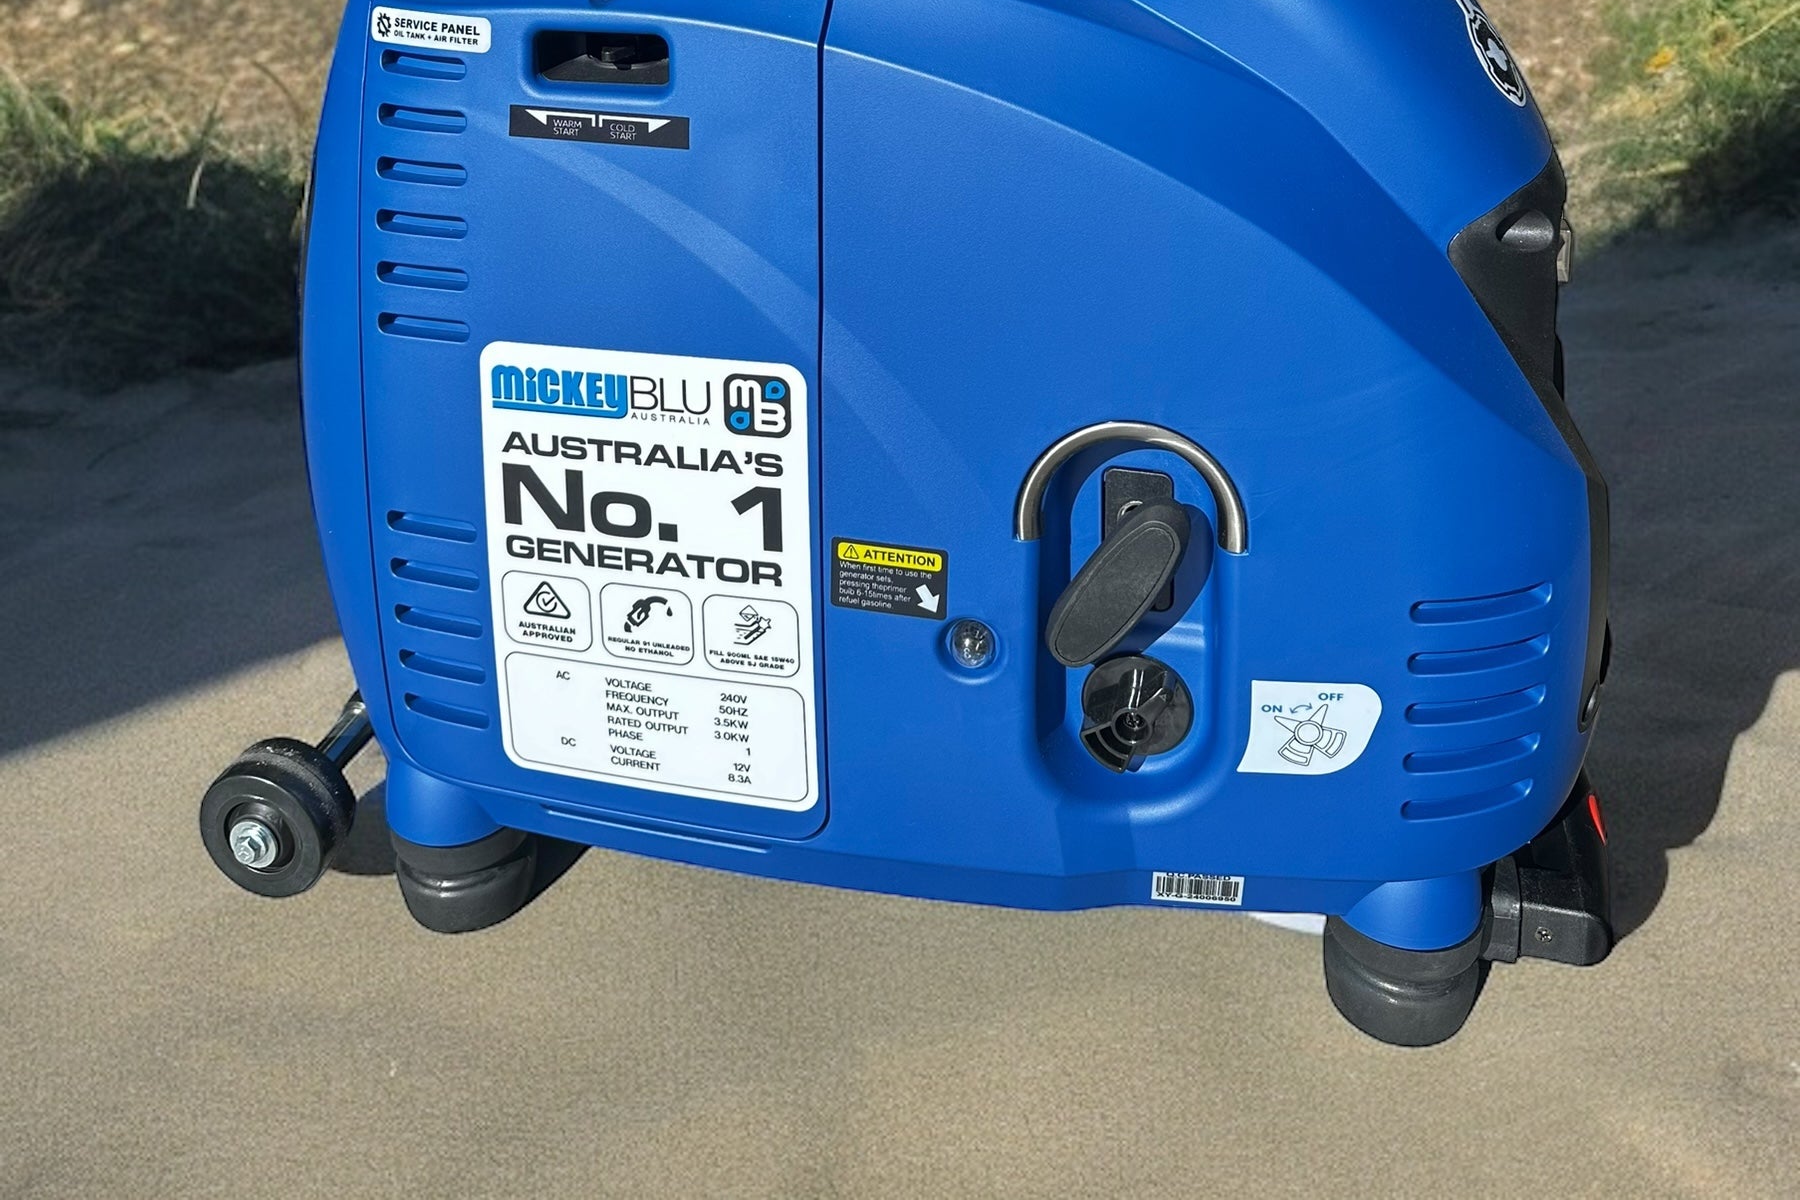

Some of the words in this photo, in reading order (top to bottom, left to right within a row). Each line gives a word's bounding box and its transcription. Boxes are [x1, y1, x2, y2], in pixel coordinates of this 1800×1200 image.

[395, 18, 437, 31] SERVICE
[442, 23, 480, 36] PANEL
[407, 32, 425, 40] TANK
[450, 37, 478, 45] FILTER
[553, 119, 582, 128] WARM
[610, 123, 635, 132] COLD
[554, 128, 578, 136] START
[610, 132, 636, 140] START
[631, 412, 710, 426] AUSTRALIA
[502, 431, 783, 477] AUSTRALIA'S
[502, 462, 678, 542] No.
[731, 486, 783, 552] 1
[506, 534, 782, 586] GENERATOR
[864, 550, 935, 566] ATTENTION
[840, 561, 860, 570] When
[840, 571, 874, 580] generator
[840, 580, 870, 590] pressing
[894, 594, 911, 602] after
[519, 621, 576, 634] AUSTRALIAN
[523, 630, 573, 642] APPROVED
[608, 636, 640, 645] REGULAR
[653, 642, 690, 651] UNLEADED
[639, 647, 674, 657] ETHANOL
[556, 671, 570, 680] AC
[605, 677, 652, 691] VOLTAGE
[606, 690, 668, 706] FREQUENCY
[721, 693, 747, 703] 240V
[1318, 692, 1344, 701] OFF
[607, 702, 632, 714] MAX.
[636, 707, 679, 720] OUTPUT
[719, 706, 748, 717] 50HZ
[608, 716, 641, 728] RATED
[645, 721, 688, 734] OUTPUT
[714, 717, 748, 729] 3.5KW
[608, 728, 643, 741] PHASE
[715, 731, 749, 742] 3.0KW
[561, 737, 576, 746] DC
[610, 744, 656, 759] VOLTAGE
[611, 756, 660, 771] CURRENT
[734, 763, 750, 772] 12V
[728, 774, 751, 784] 8.3A
